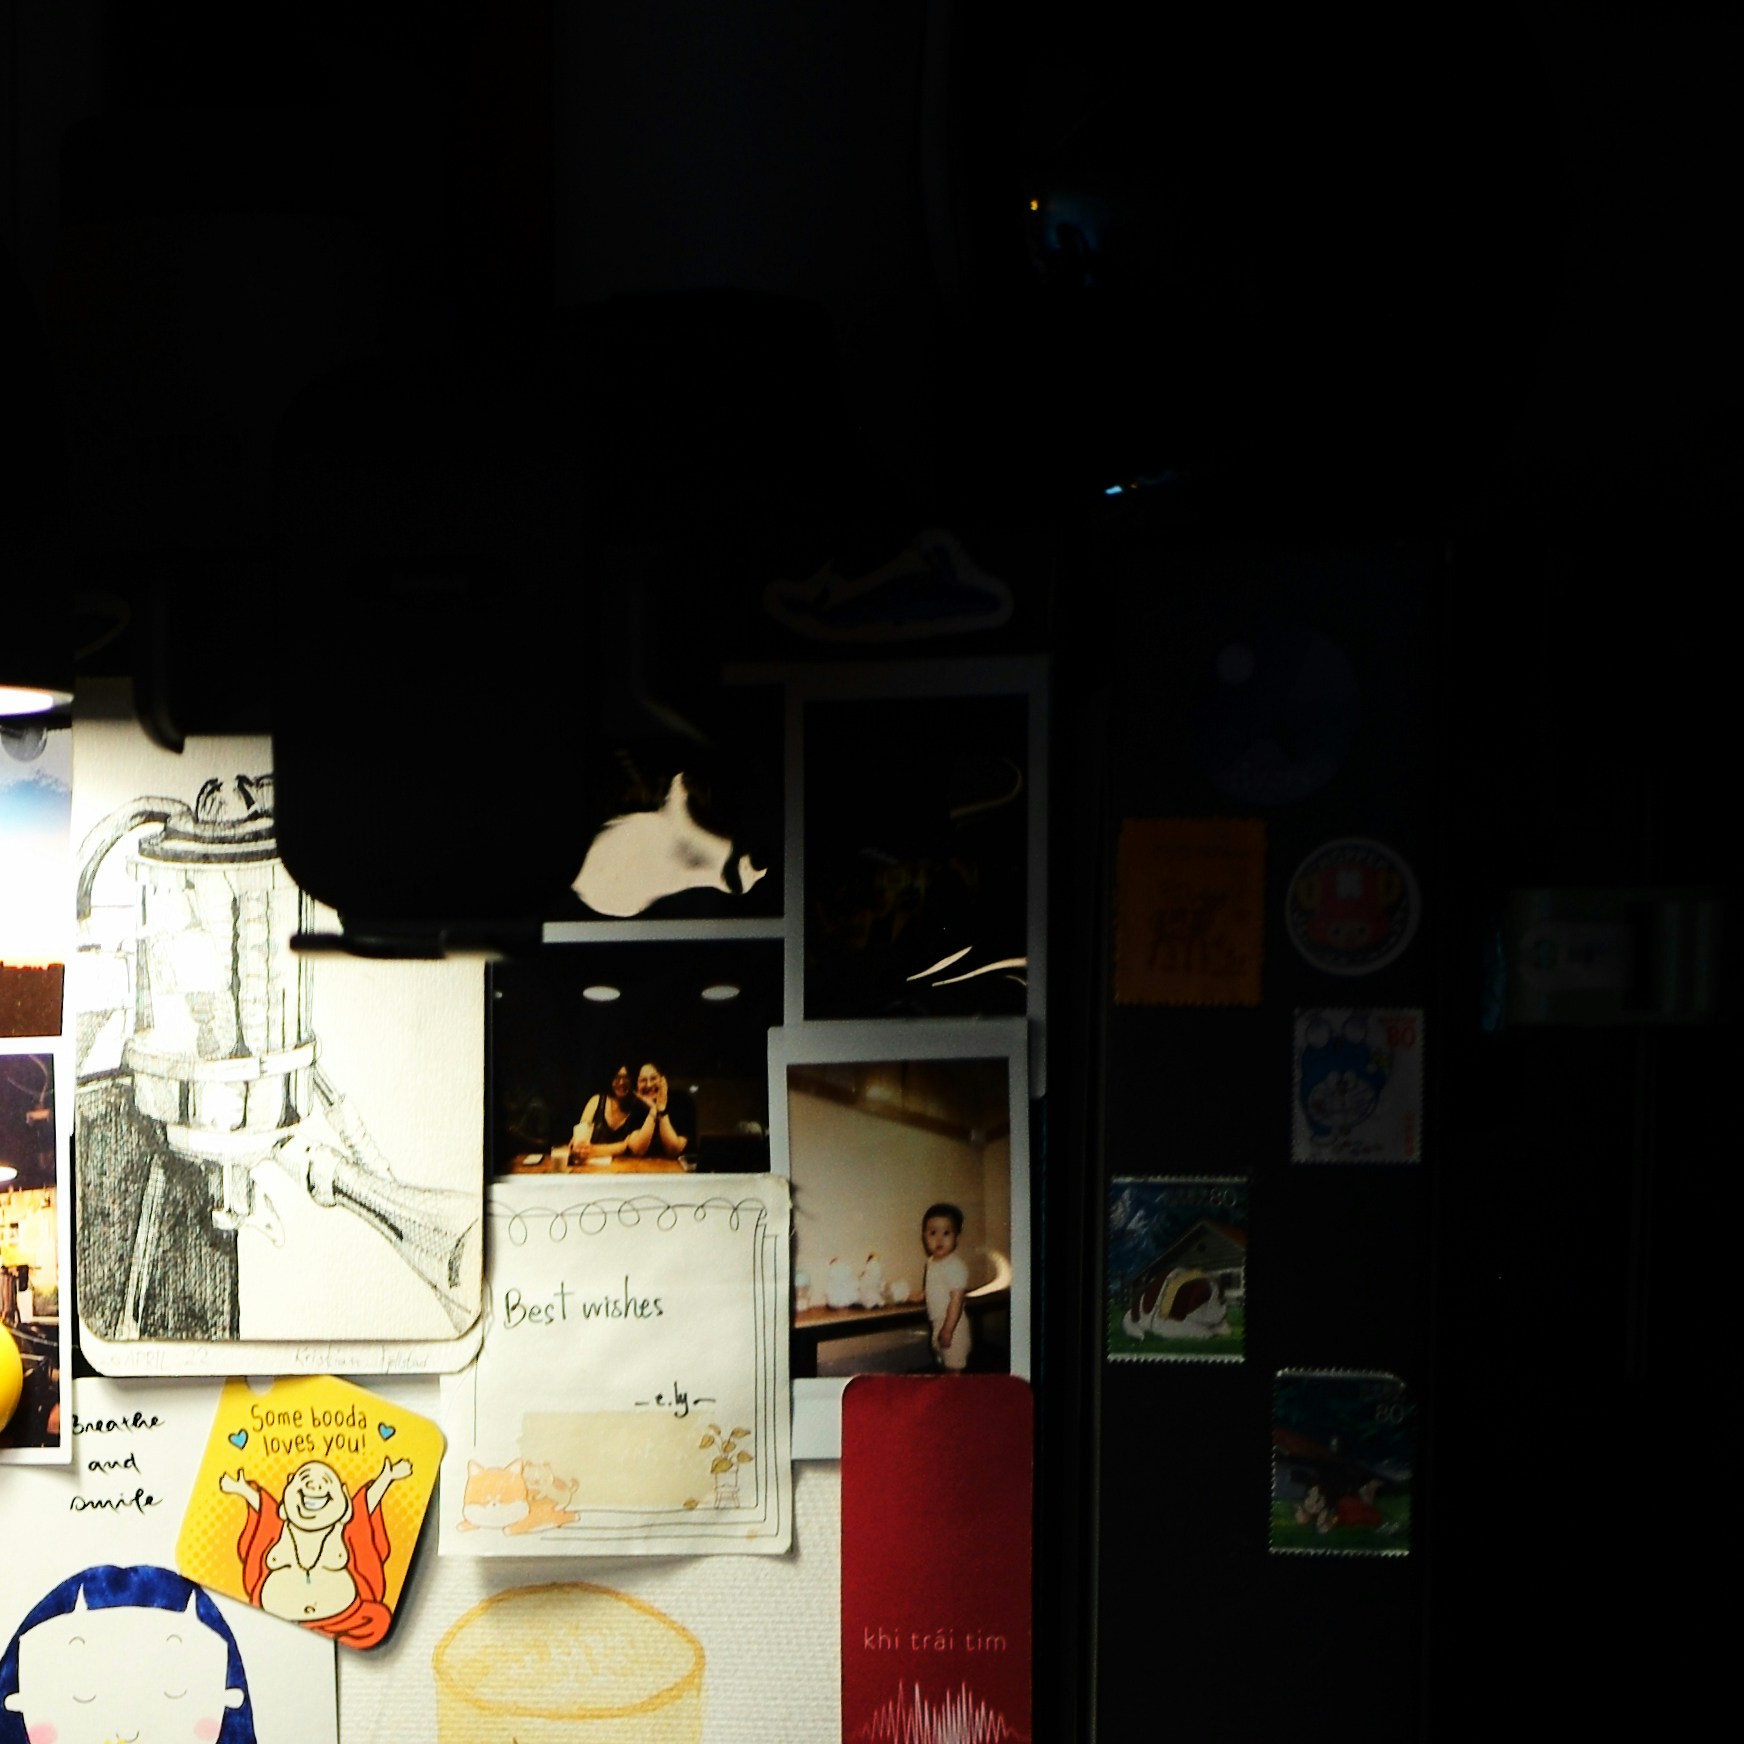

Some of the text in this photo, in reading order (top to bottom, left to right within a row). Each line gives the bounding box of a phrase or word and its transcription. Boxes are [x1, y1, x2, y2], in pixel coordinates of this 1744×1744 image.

[582, 1275, 664, 1320] wishes
[251, 1404, 367, 1433] Some booda
[262, 1434, 367, 1457] loves you!
[88, 1452, 141, 1474] and
[70, 1488, 164, 1515] smile
[863, 1627, 1007, 1651] khi trái tim
